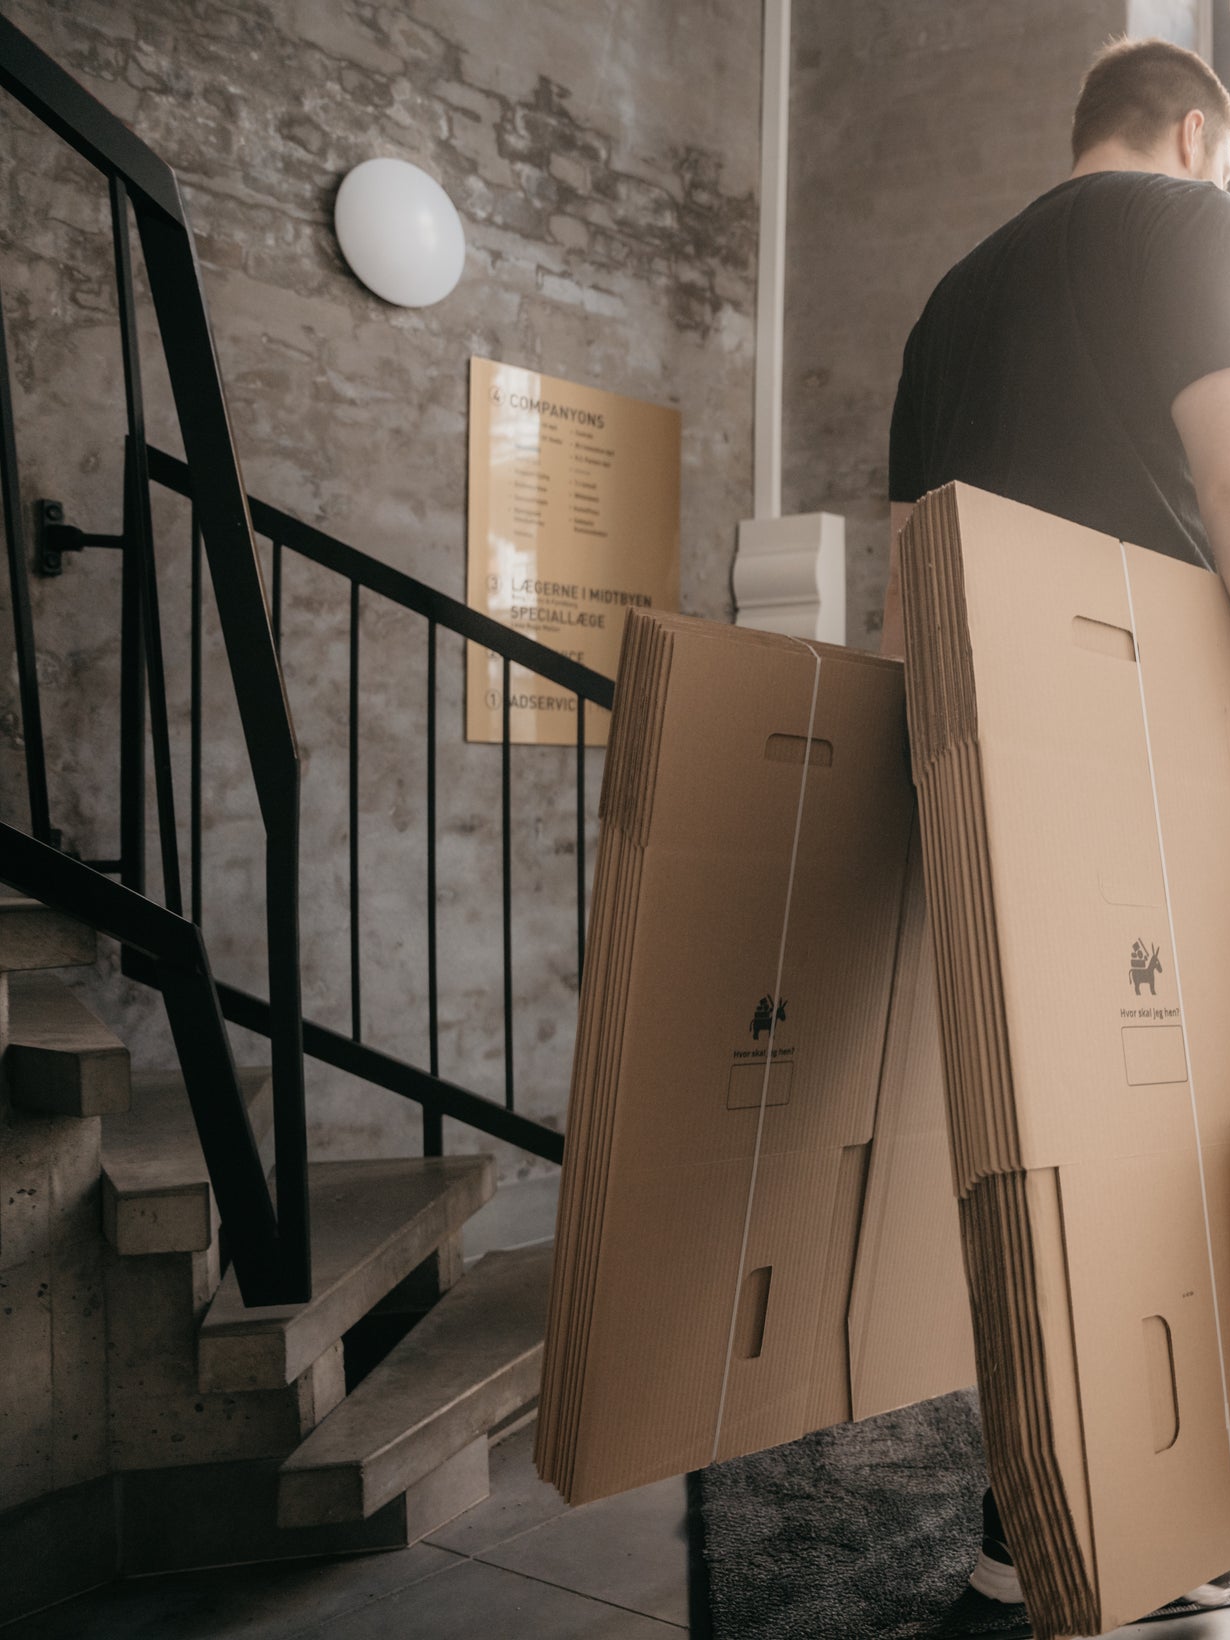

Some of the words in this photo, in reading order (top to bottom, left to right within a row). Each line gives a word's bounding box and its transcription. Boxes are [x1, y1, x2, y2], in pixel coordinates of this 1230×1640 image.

[510, 393, 605, 429] COMPANYONS
[511, 577, 578, 600] LÆGERNE
[589, 588, 652, 608] MIDTBYEN
[511, 606, 605, 629] SPECIALLÆGE
[1120, 1008, 1136, 1018] Hvor
[1138, 1008, 1152, 1018] skal
[1152, 1008, 1164, 1020] jeg
[1164, 1008, 1179, 1018] hen?
